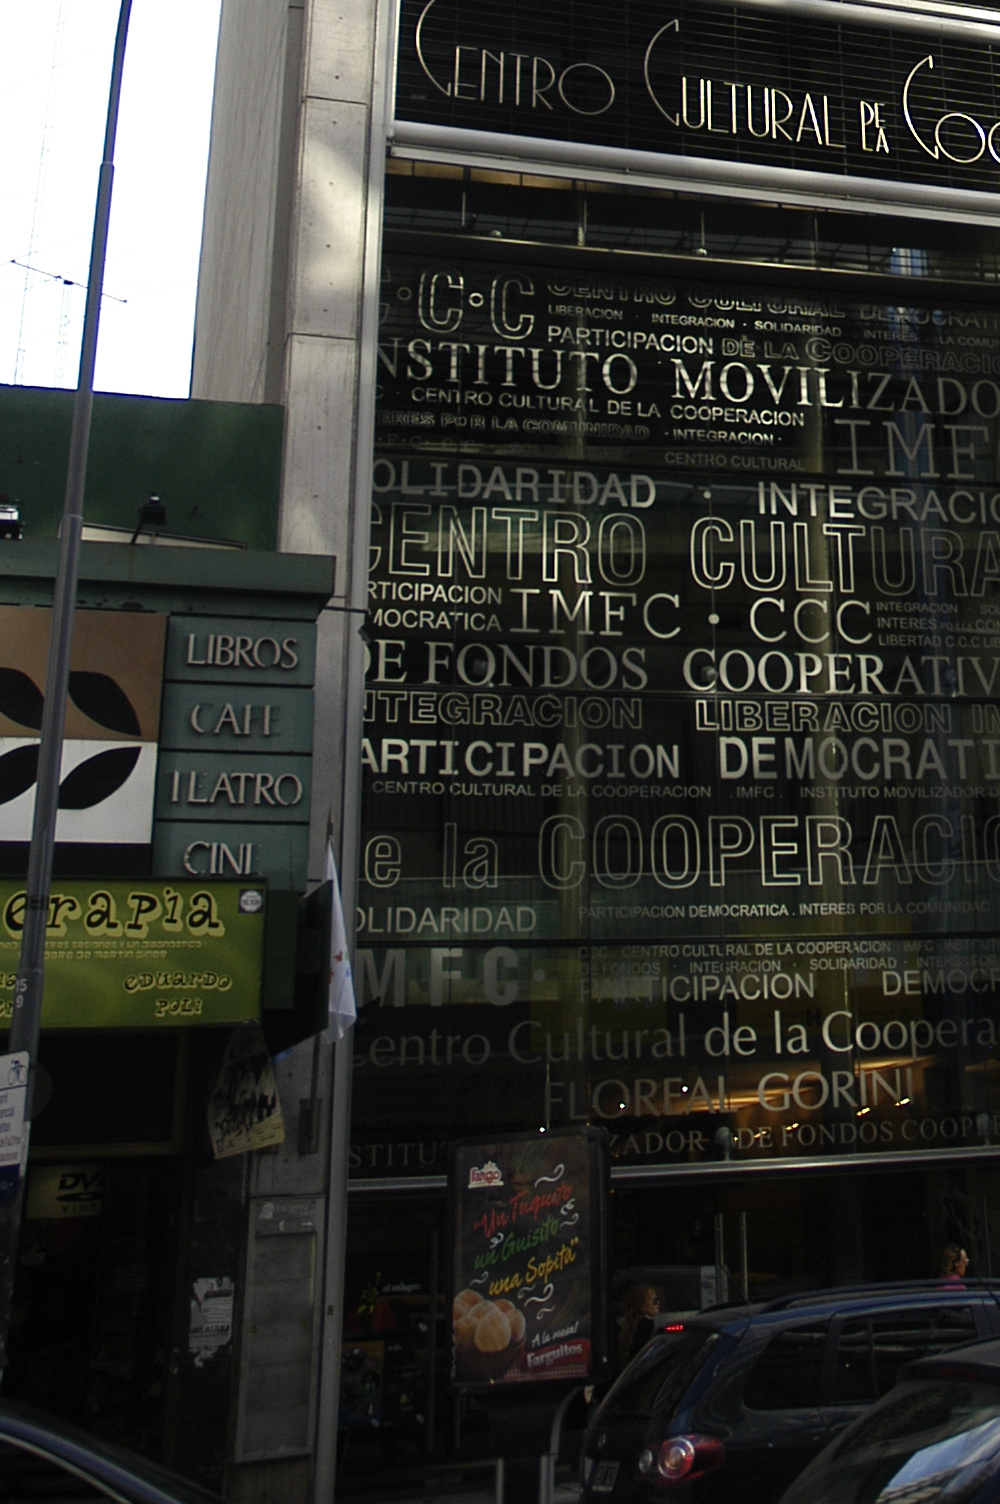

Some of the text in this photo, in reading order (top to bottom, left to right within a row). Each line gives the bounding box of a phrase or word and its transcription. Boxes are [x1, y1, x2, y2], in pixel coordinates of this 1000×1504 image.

[644, 18, 846, 150] CULTURAL
[548, 304, 623, 321] LIBERACION
[652, 312, 735, 330] INTEGRACION
[754, 319, 842, 338] SOLIDARIDAD
[548, 325, 714, 356] PARTICIPACION
[764, 342, 799, 361] LA
[376, 336, 638, 396] NSTITUTO
[411, 386, 805, 427] CENTRO CULTURAL DE LA COOPERACION
[377, 410, 435, 427] ERES
[522, 418, 650, 442] COMUNIDAD
[673, 428, 774, 446] INTEGRACION
[664, 450, 805, 472] CENTRO CULTURAL
[372, 457, 657, 509] OLIDARIDAD
[367, 580, 503, 605] RTICIPACION
[876, 601, 958, 615] INTEGRACION
[372, 607, 502, 633] MOCRATICA
[509, 587, 682, 640] IMFC
[877, 616, 937, 630] INTERES
[187, 632, 299, 670] LIBROS
[878, 633, 943, 648] LIBERTAD
[424, 640, 649, 691] FONDOS
[695, 698, 951, 734] LIBERACION
[361, 737, 680, 779] ARTICIPACION
[372, 780, 445, 795] CENTRO
[448, 782, 536, 797] CULTURAL
[540, 784, 562, 798] DE
[567, 784, 588, 798] LA
[591, 785, 712, 799] COOPERACION
[736, 785, 776, 799] IMFC
[800, 786, 880, 799] INSTITUTO
[883, 785, 985, 799] MOVILIZADOR
[364, 834, 401, 888] e
[442, 821, 499, 890] la
[3, 886, 223, 936] erapia
[579, 905, 686, 920] PARTICIPACION
[688, 904, 788, 919] DEMOCRATICA
[799, 902, 856, 916] INTERES
[859, 901, 885, 916] POR
[887, 901, 905, 915] LA
[906, 899, 991, 914] COMUNIDAD
[600, 961, 662, 977] FONDOS
[689, 959, 782, 975] INTEGRACION
[809, 956, 898, 972] SOLIDARIDAD
[621, 944, 680, 960] CENTRO
[682, 942, 752, 958] CULTURAL
[755, 942, 774, 957] DE
[776, 941, 794, 956] LA
[796, 939, 892, 956] COOPERACION
[356, 946, 521, 1008] MFC
[579, 972, 816, 1005] PARTICIPACION
[508, 1010, 687, 1064] Cultural
[704, 1011, 757, 1057] de
[774, 1010, 811, 1055] la
[545, 1066, 914, 1120] FLOREAL GORINI
[737, 1125, 774, 1150] DE
[780, 1120, 894, 1147] FONDOS
